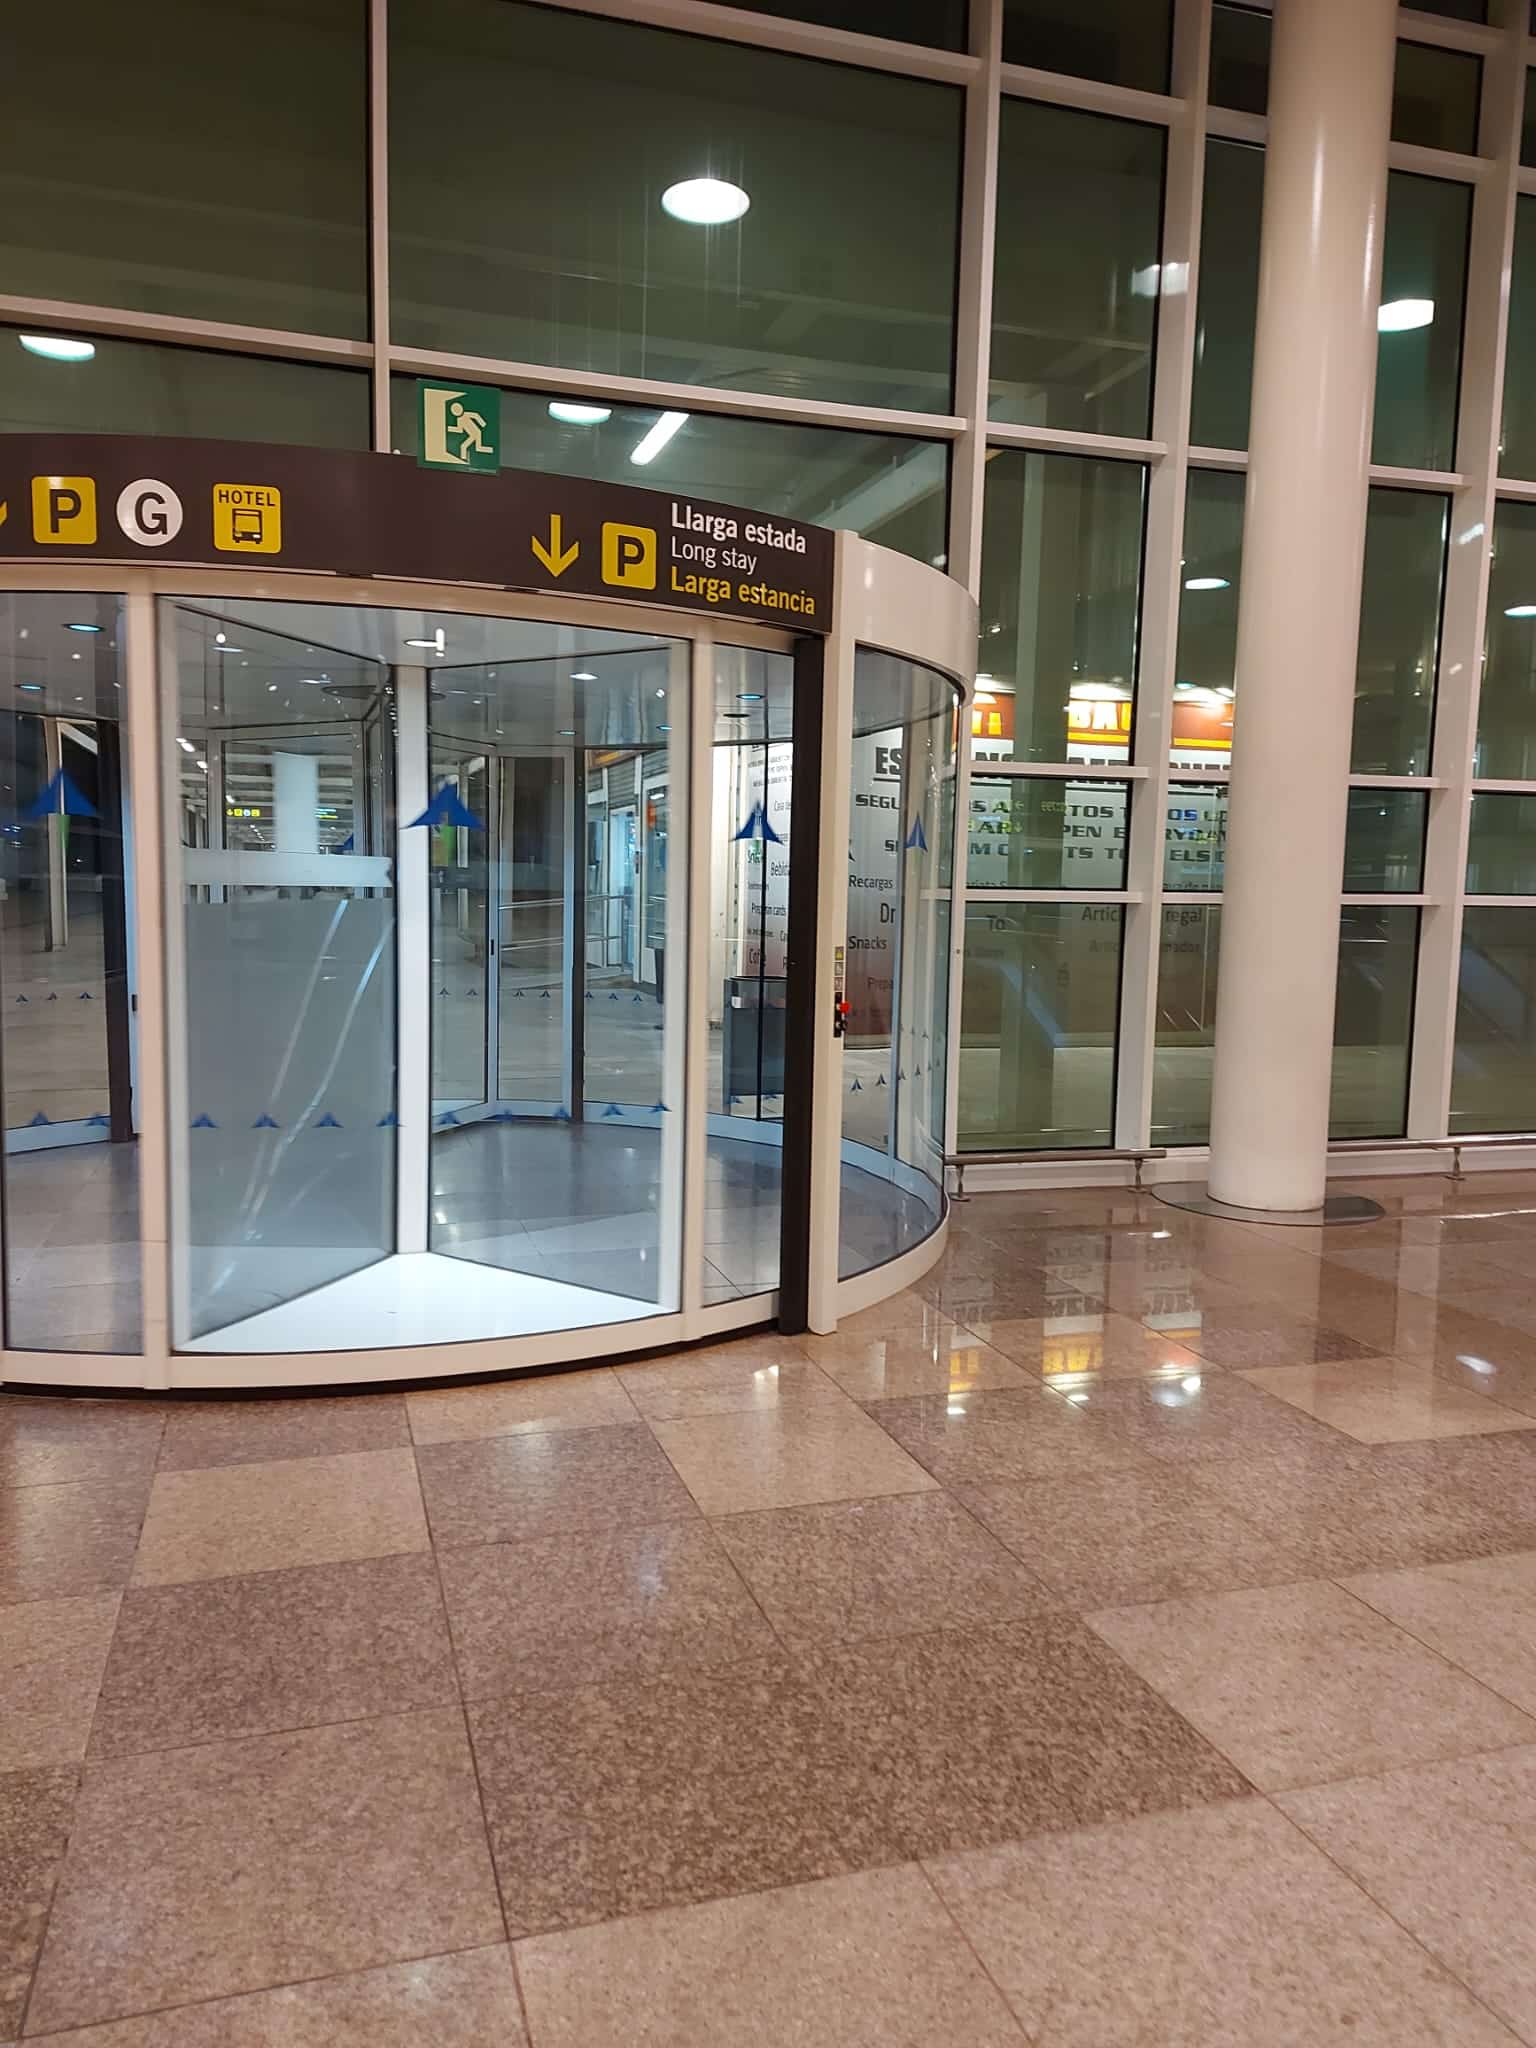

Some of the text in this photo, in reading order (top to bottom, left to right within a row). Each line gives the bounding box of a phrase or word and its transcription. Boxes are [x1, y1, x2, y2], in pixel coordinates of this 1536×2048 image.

[49, 488, 276, 536] P G HOTEL
[671, 502, 807, 554] Llarga estada
[617, 534, 645, 577] P
[671, 535, 757, 576] Long stay
[671, 566, 815, 616] Larga estancia
[848, 874, 893, 892] Recargas
[848, 935, 888, 951] Snacks
